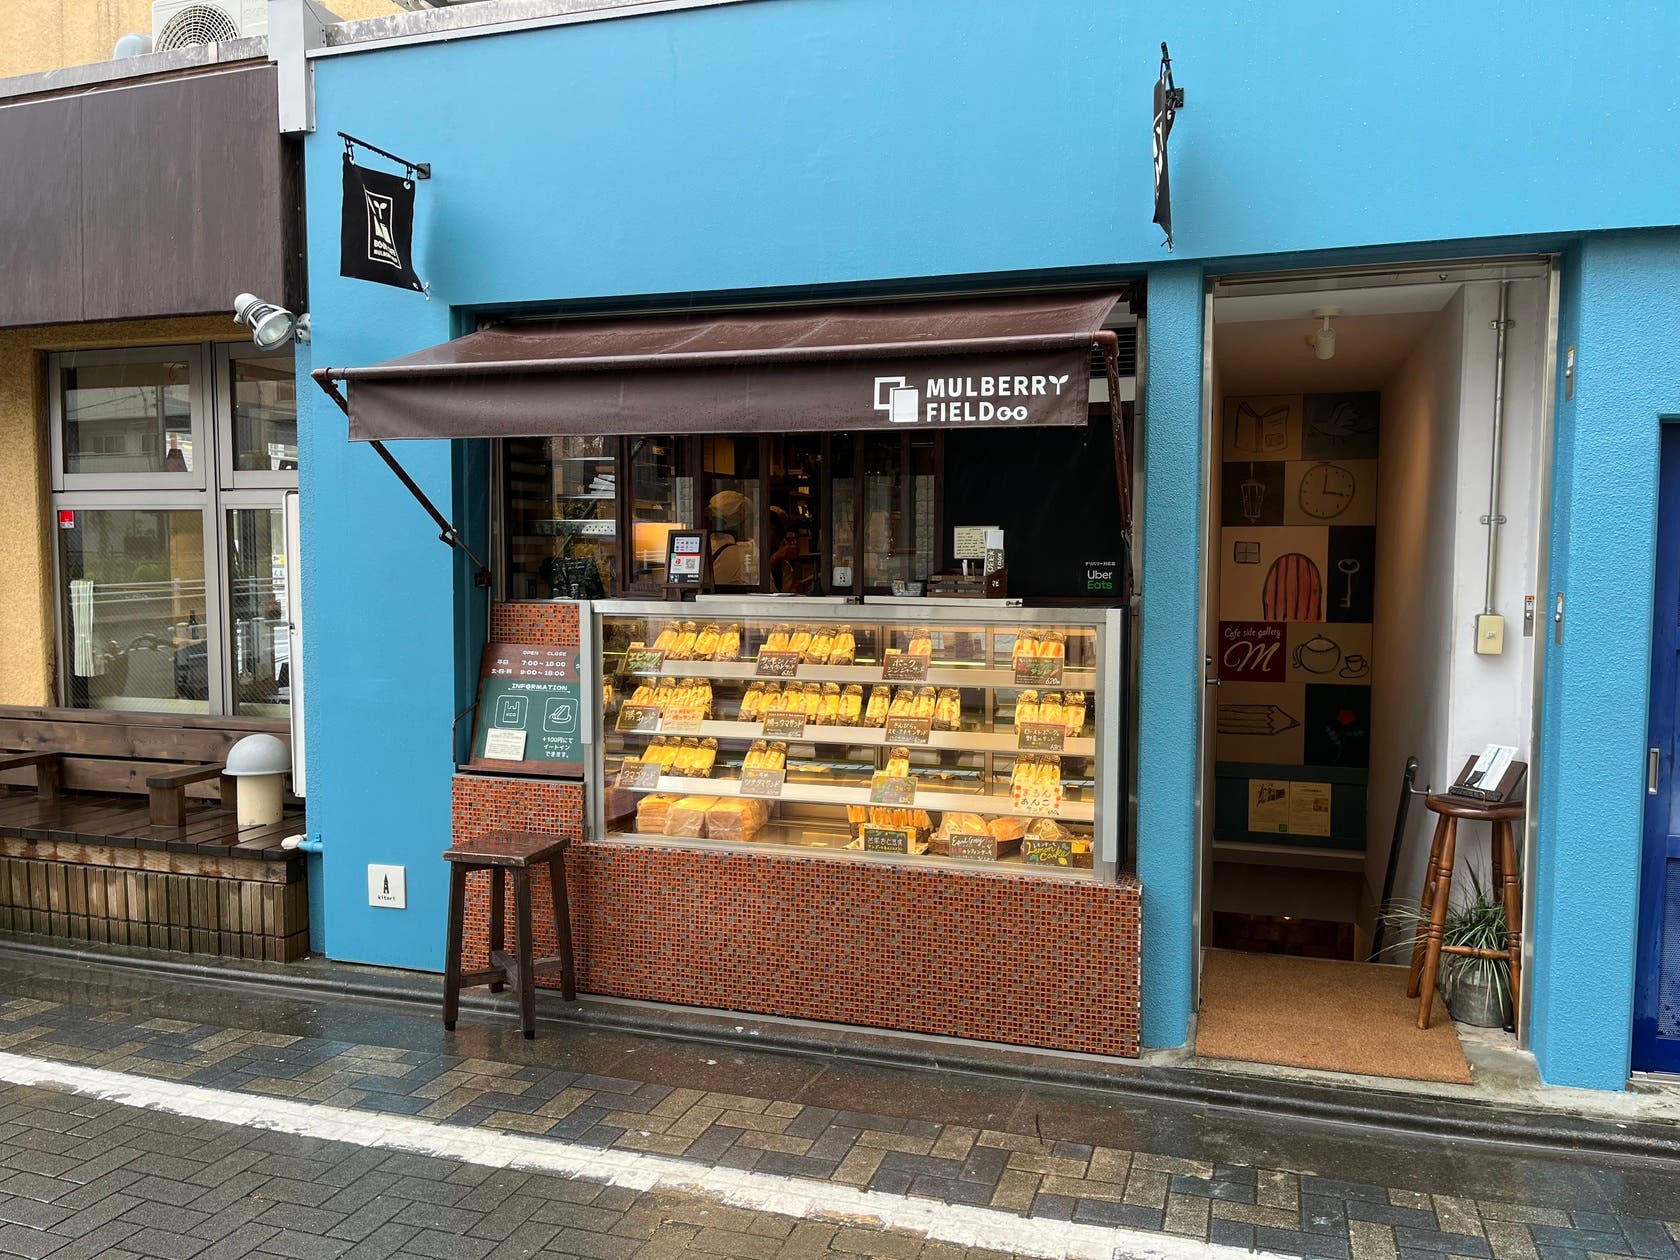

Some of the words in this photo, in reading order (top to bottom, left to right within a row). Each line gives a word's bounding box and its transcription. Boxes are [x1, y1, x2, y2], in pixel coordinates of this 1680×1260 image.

[926, 374, 1069, 398] MULBERRY
[1087, 570, 1113, 579] Uber
[1087, 580, 1113, 589] Eats
[1224, 627, 1241, 641] Cafe
[1243, 627, 1256, 637] side
[1258, 627, 1281, 639] gallery
[1223, 640, 1281, 673] M
[511, 683, 568, 691] INFORMATION
[1020, 798, 1050, 806] あんこ
[1026, 842, 1056, 855] Lemon
